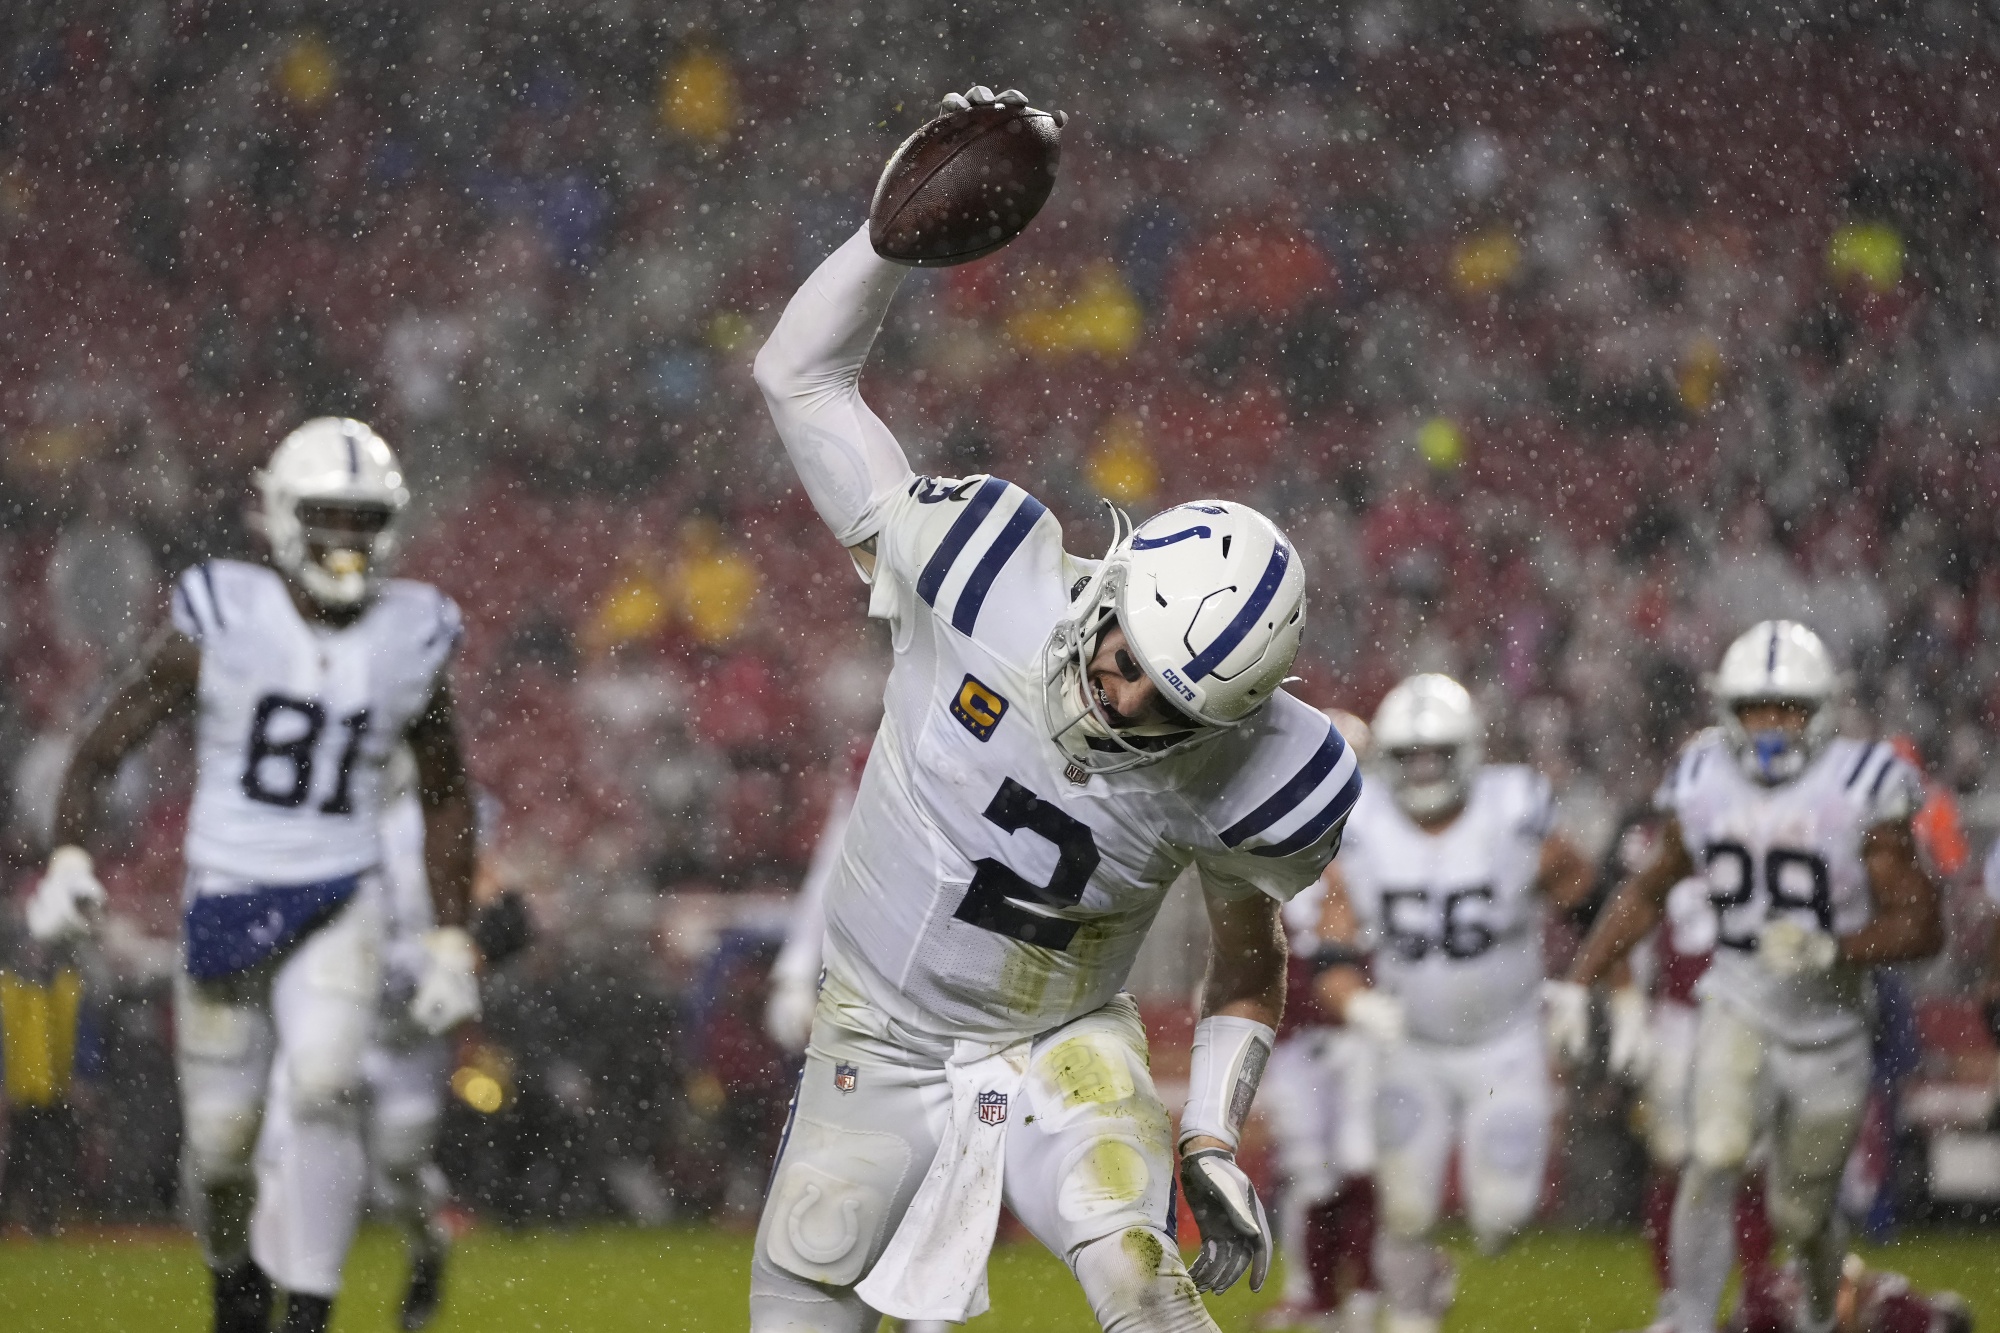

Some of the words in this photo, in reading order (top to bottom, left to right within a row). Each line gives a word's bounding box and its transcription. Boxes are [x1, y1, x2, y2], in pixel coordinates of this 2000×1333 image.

[960, 681, 1002, 727] C
[1162, 668, 1196, 702] COLTS
[241, 694, 371, 815] 81
[953, 775, 1102, 952] 2
[1381, 886, 1494, 961] 56
[836, 1075, 855, 1089] NFL
[981, 1104, 1005, 1122] NFL
